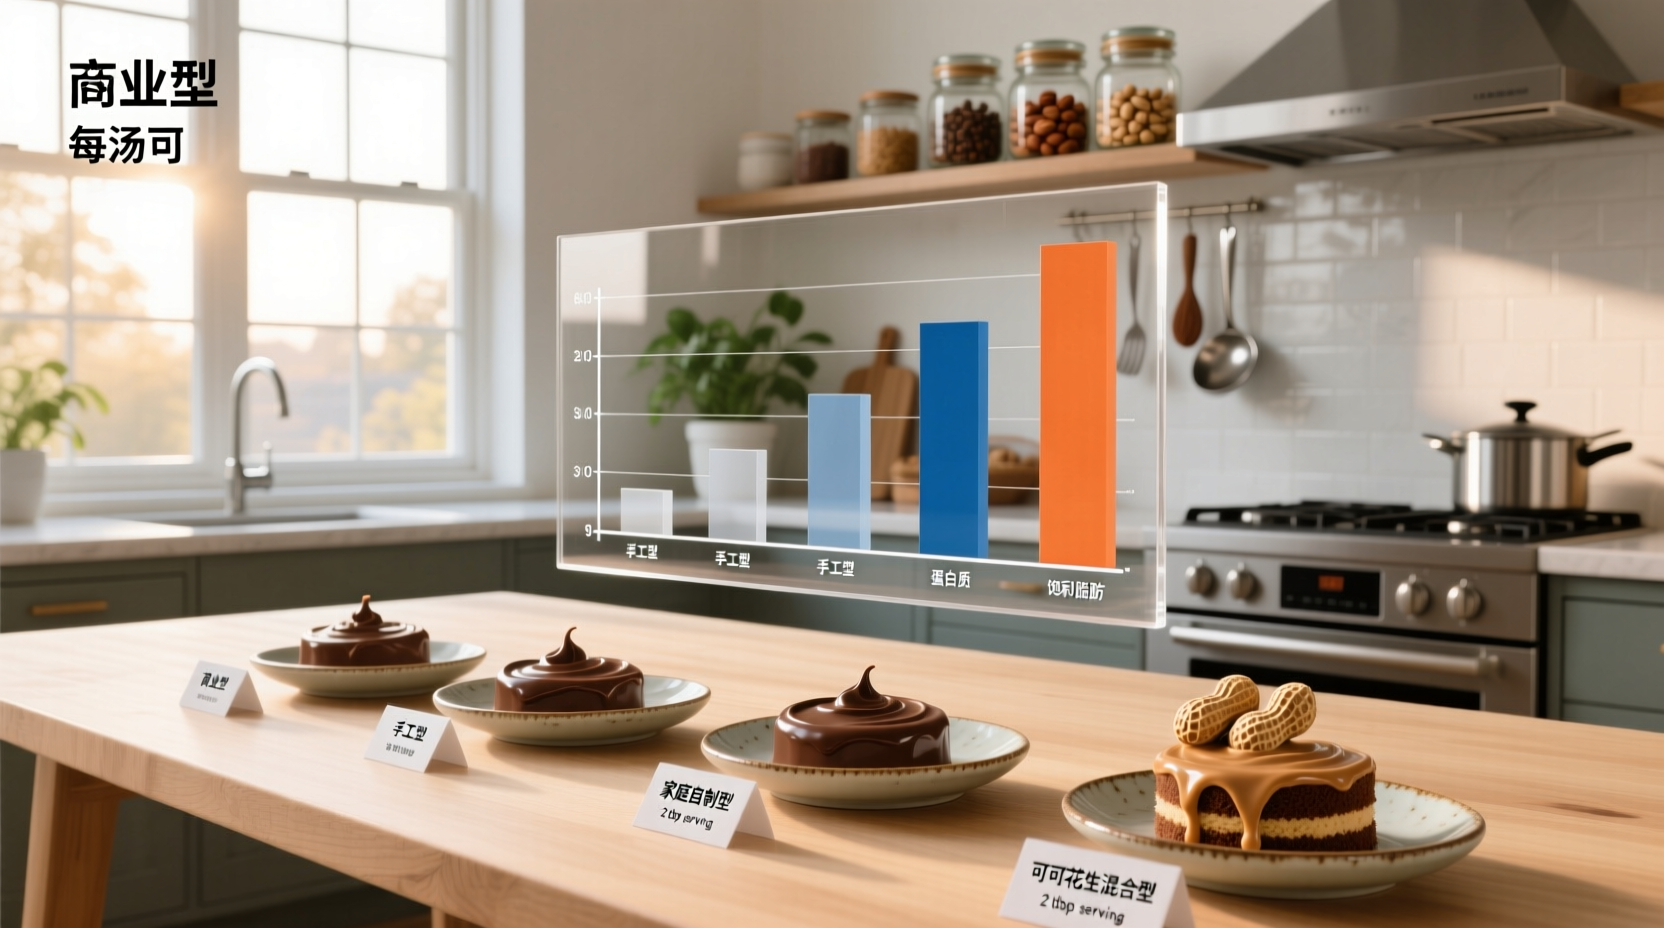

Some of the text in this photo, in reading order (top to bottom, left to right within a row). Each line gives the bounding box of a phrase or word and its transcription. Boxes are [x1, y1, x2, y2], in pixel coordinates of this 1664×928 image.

[816, 558, 855, 576] 手工型
[660, 807, 668, 818] 2
[1032, 861, 1157, 904] 可可花生混合型
[1040, 893, 1050, 908] 2
[1079, 903, 1125, 926] serving
